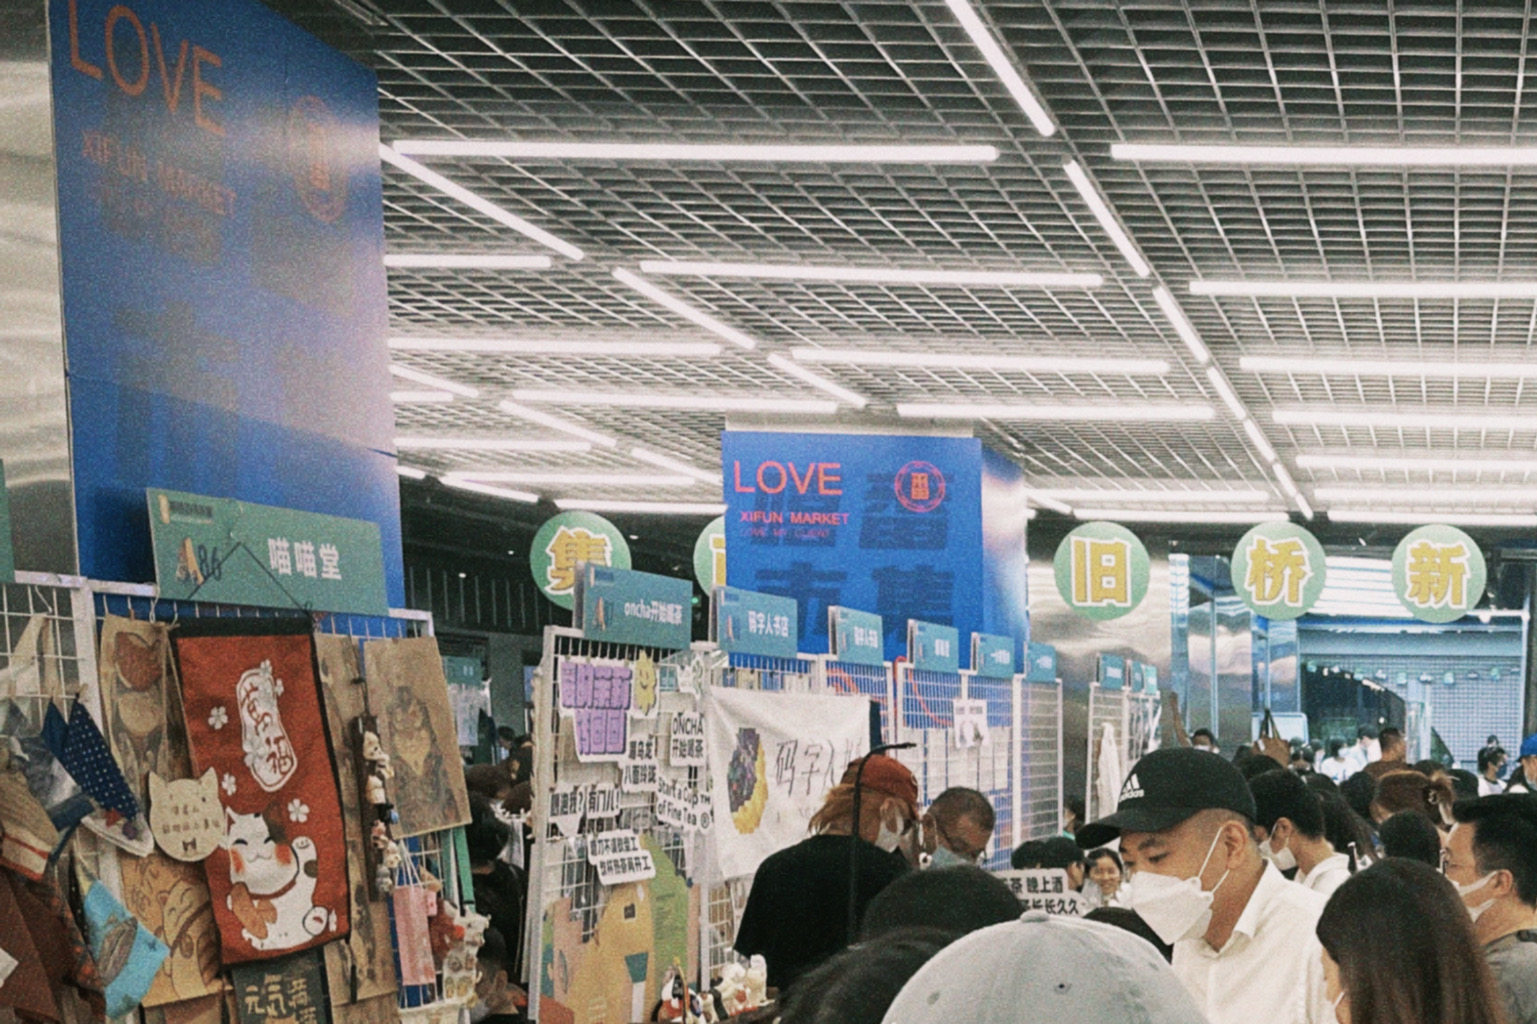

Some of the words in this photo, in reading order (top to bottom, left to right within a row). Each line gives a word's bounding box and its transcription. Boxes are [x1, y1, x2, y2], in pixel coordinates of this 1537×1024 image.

[69, 0, 227, 137] LOVE
[734, 460, 843, 495] LOVE
[740, 511, 783, 524] XIFUN
[790, 511, 850, 526] MARKET
[1071, 538, 1131, 605] 旧
[1248, 536, 1310, 605] 桥
[1405, 541, 1472, 608] 新
